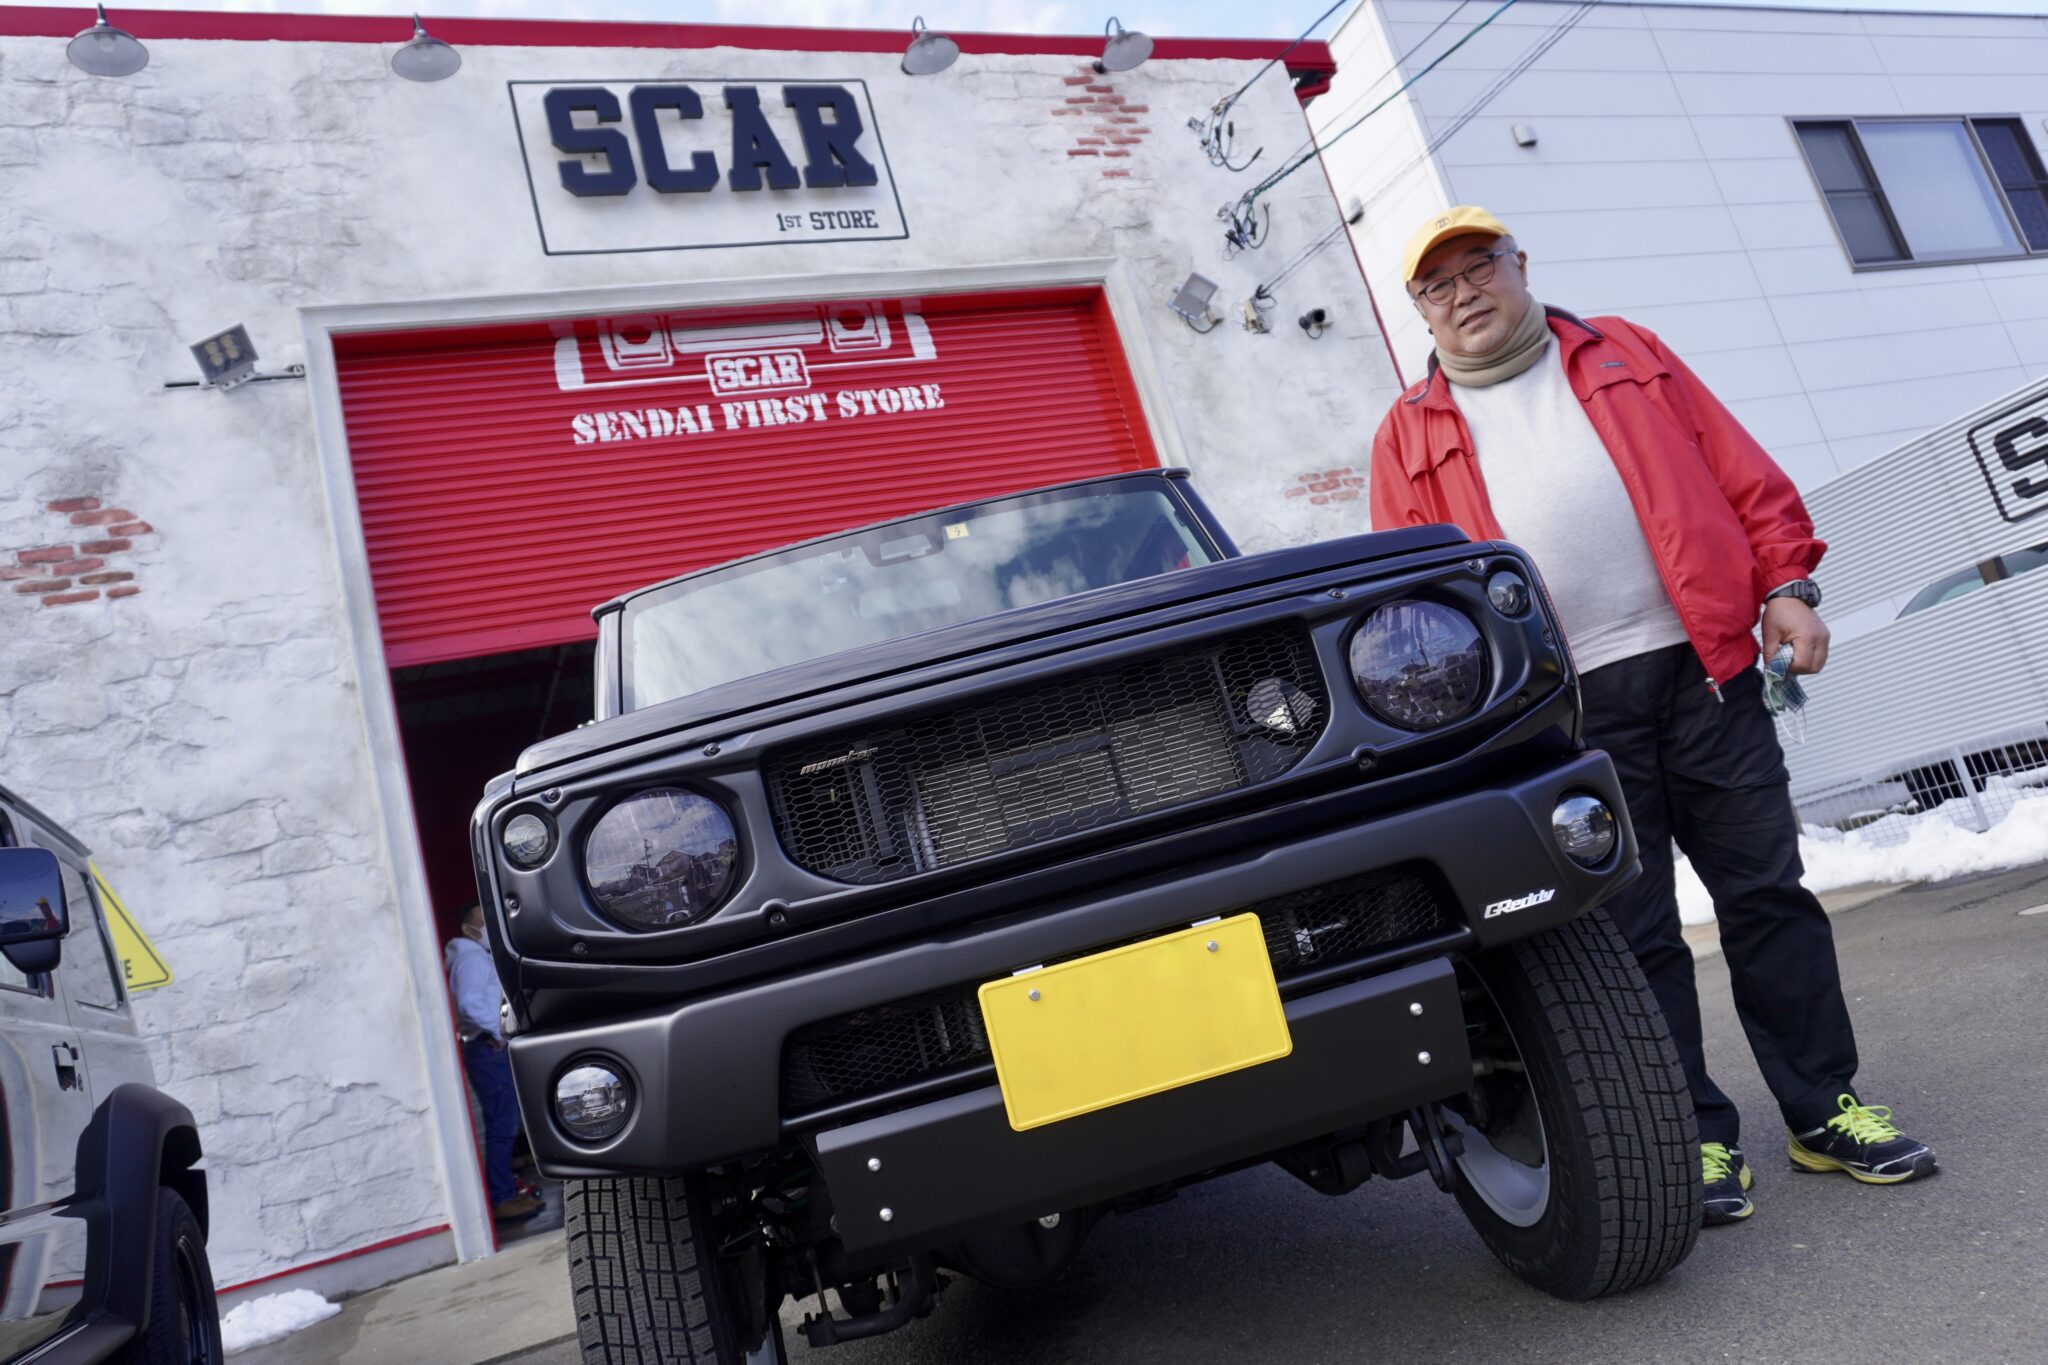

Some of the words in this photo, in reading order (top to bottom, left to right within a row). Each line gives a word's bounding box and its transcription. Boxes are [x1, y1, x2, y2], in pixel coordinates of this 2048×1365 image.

[543, 85, 878, 197] SCAR
[777, 212, 802, 232] 1ST
[809, 209, 879, 231] STORE
[712, 354, 802, 389] SCAR
[571, 404, 715, 445] SENDAI
[720, 392, 830, 430] FIRST
[835, 383, 946, 418] STORE
[1483, 888, 1556, 919] GReddy
